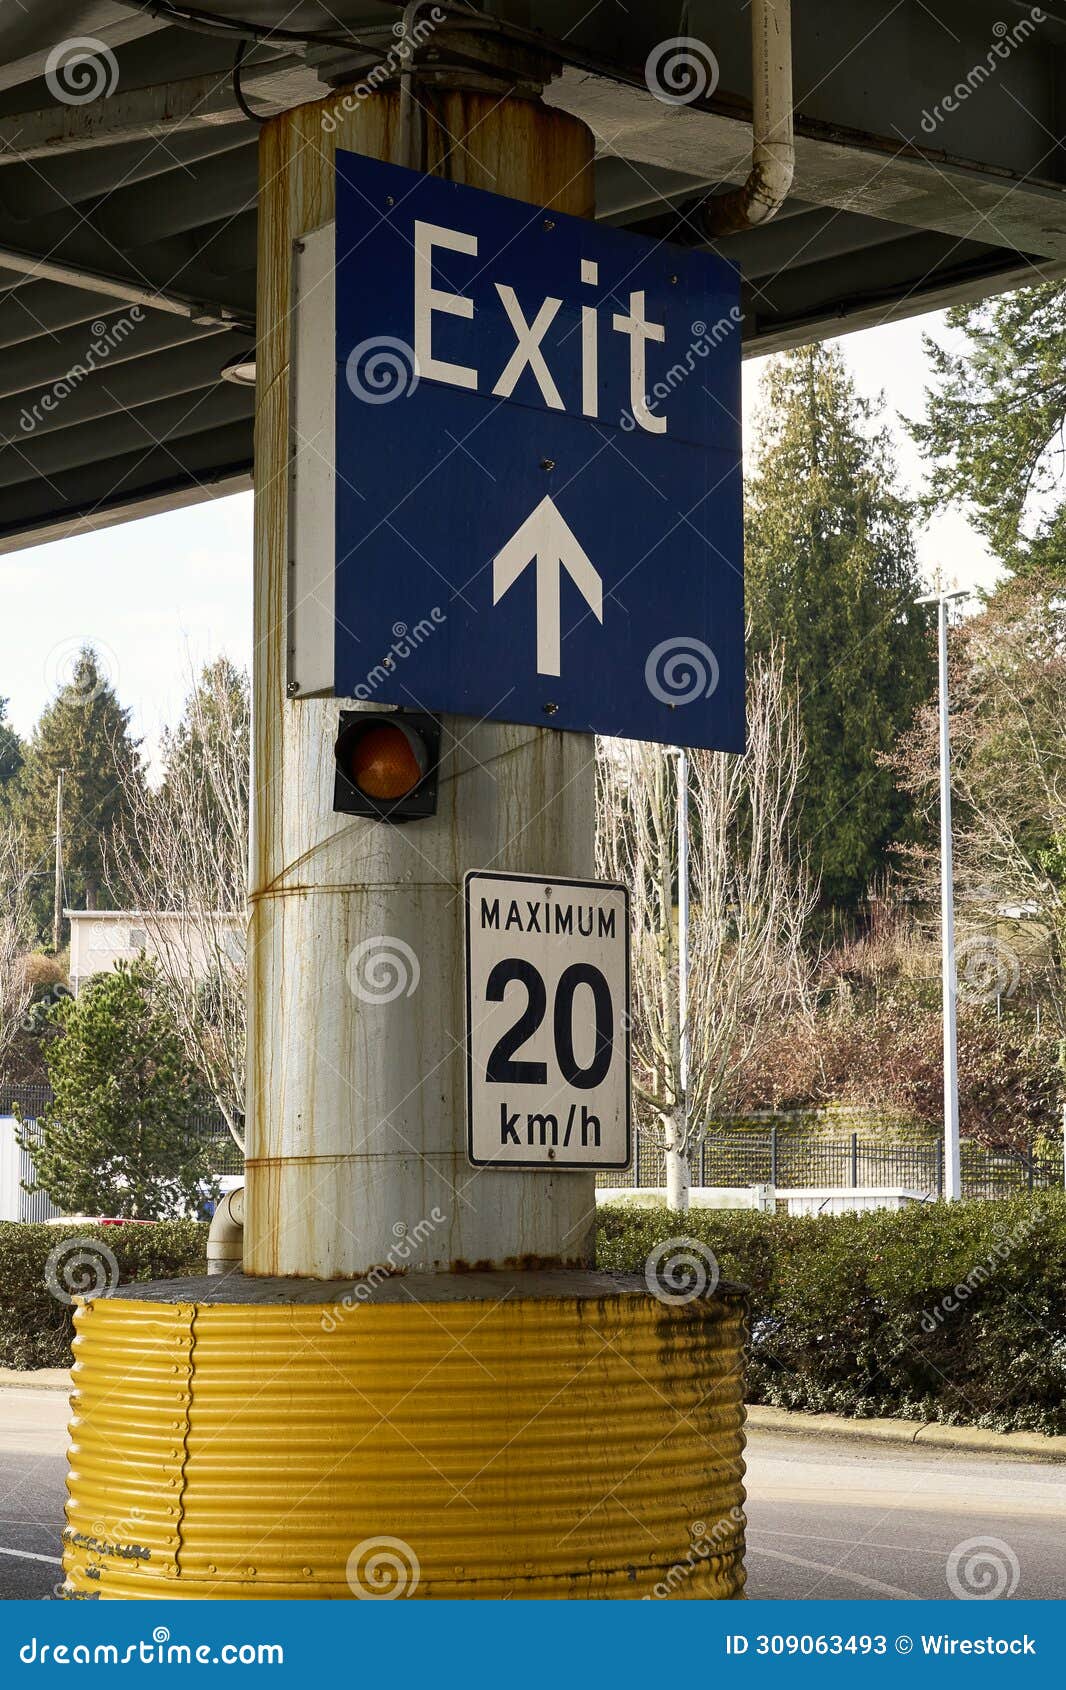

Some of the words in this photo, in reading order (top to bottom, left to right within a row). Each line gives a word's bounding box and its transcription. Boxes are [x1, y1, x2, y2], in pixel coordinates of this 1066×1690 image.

[414, 220, 667, 434] Exit
[480, 898, 616, 939] MAXIMUM
[485, 958, 614, 1090] 20
[500, 1102, 601, 1147] km/h
